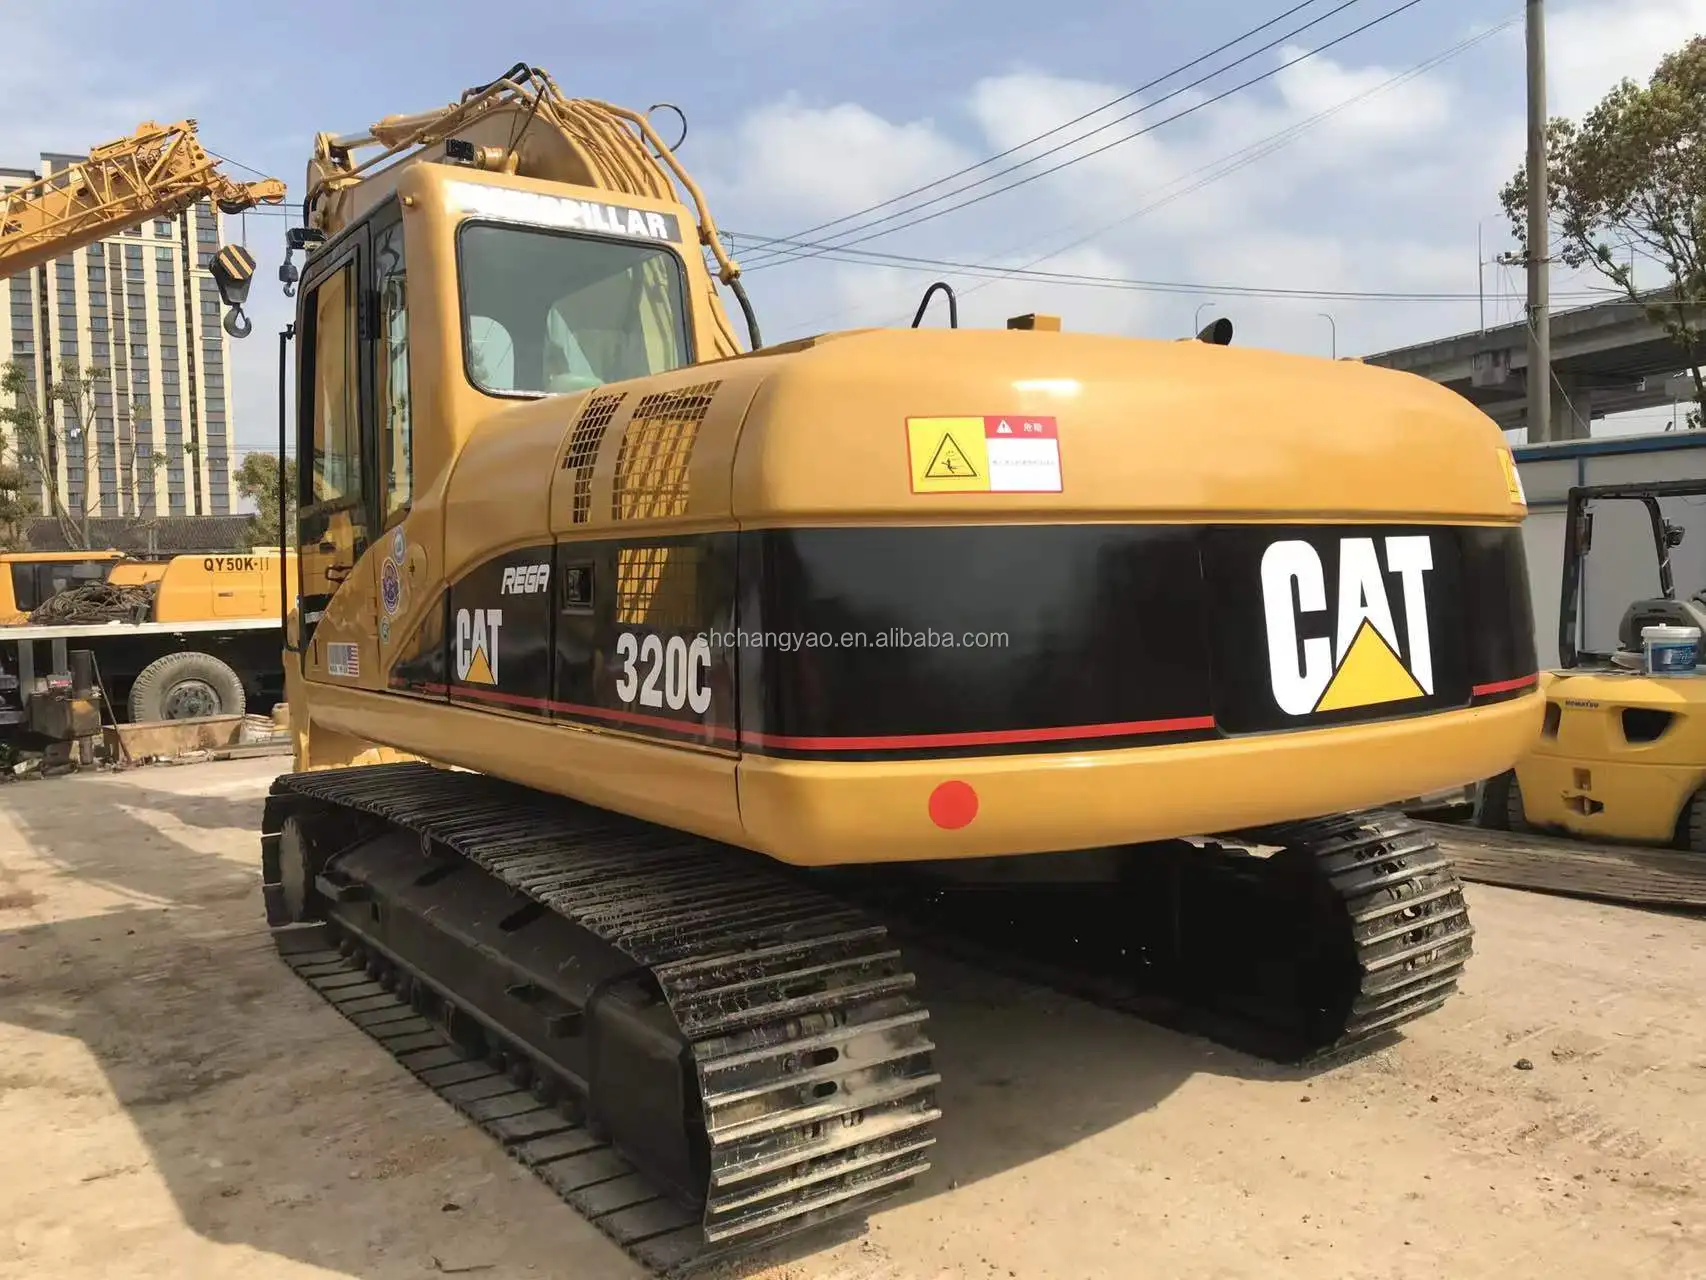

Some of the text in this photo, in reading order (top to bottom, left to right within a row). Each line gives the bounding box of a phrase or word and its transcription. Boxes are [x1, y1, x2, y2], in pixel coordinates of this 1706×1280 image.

[451, 183, 668, 239] PILLAR
[501, 564, 550, 595] REGA
[456, 608, 503, 685] CAT
[1260, 535, 1434, 716] CAT
[616, 632, 712, 714] 320C
